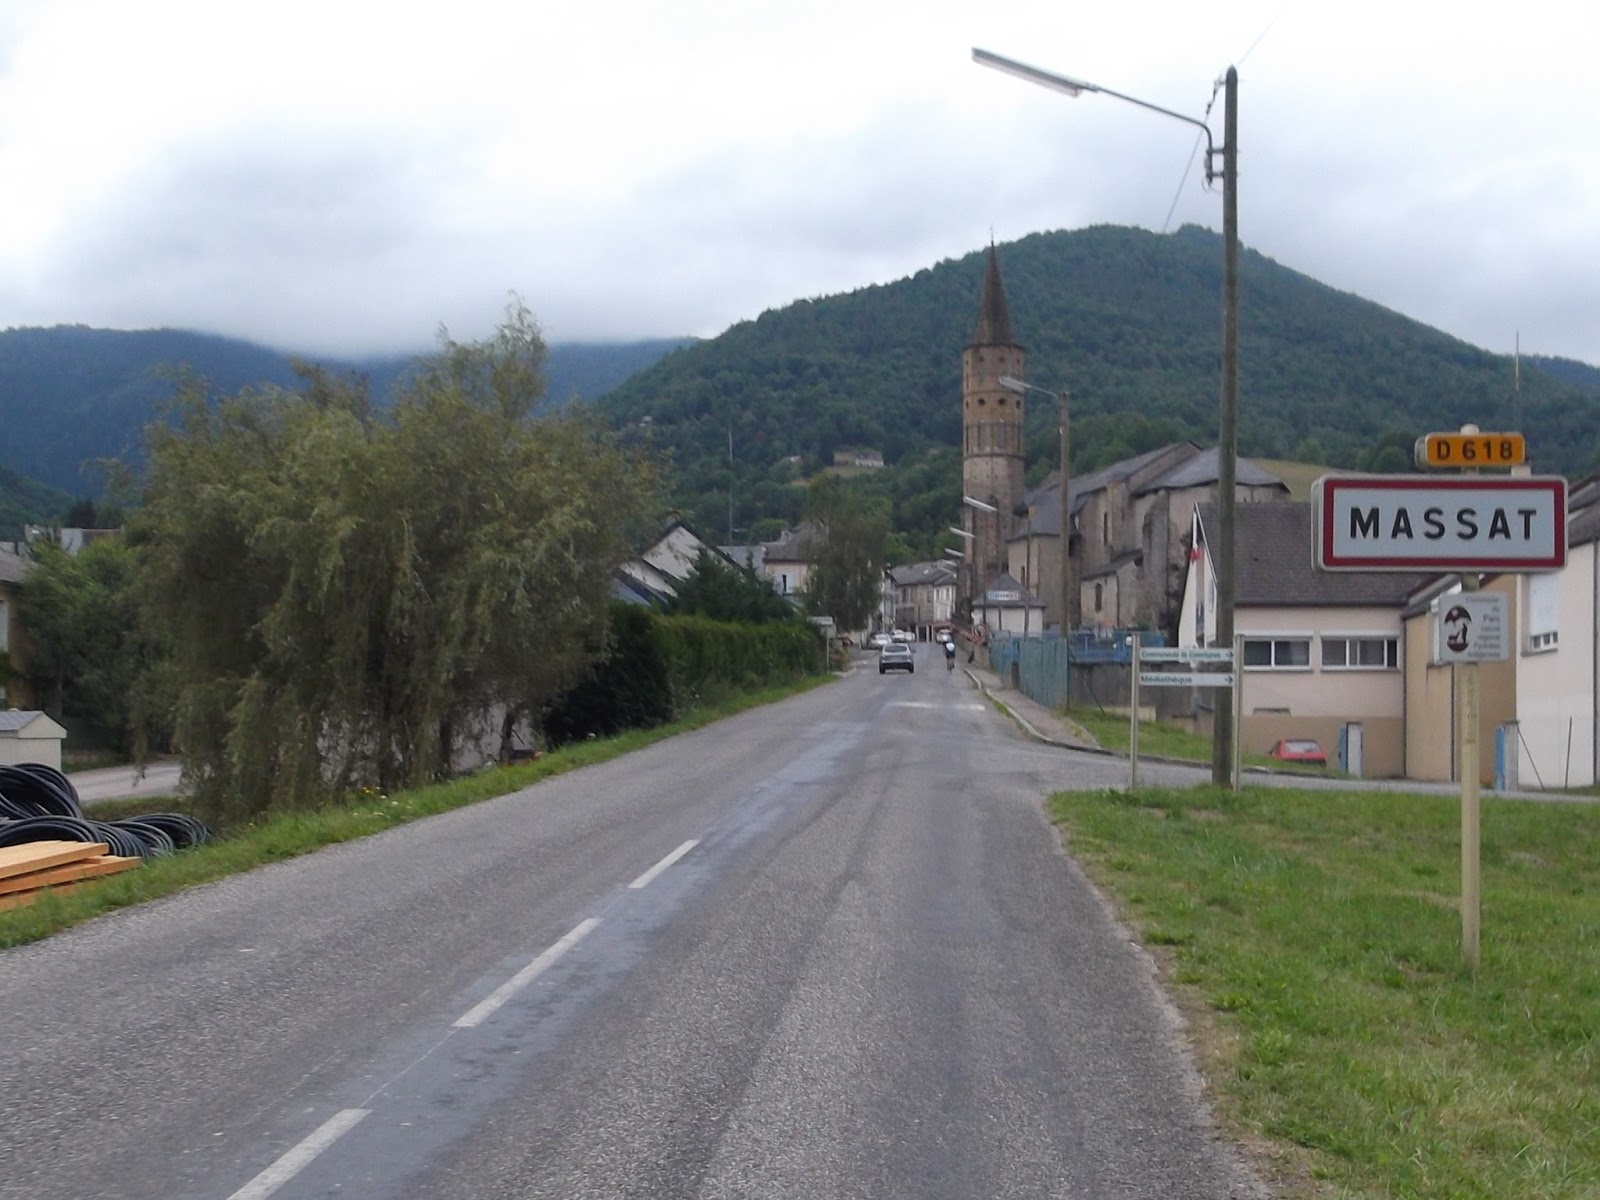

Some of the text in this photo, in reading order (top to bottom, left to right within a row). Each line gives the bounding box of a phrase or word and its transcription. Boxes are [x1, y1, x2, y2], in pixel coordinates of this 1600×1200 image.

[1436, 440, 1513, 460] D 618
[1350, 507, 1537, 540] MASSAT
